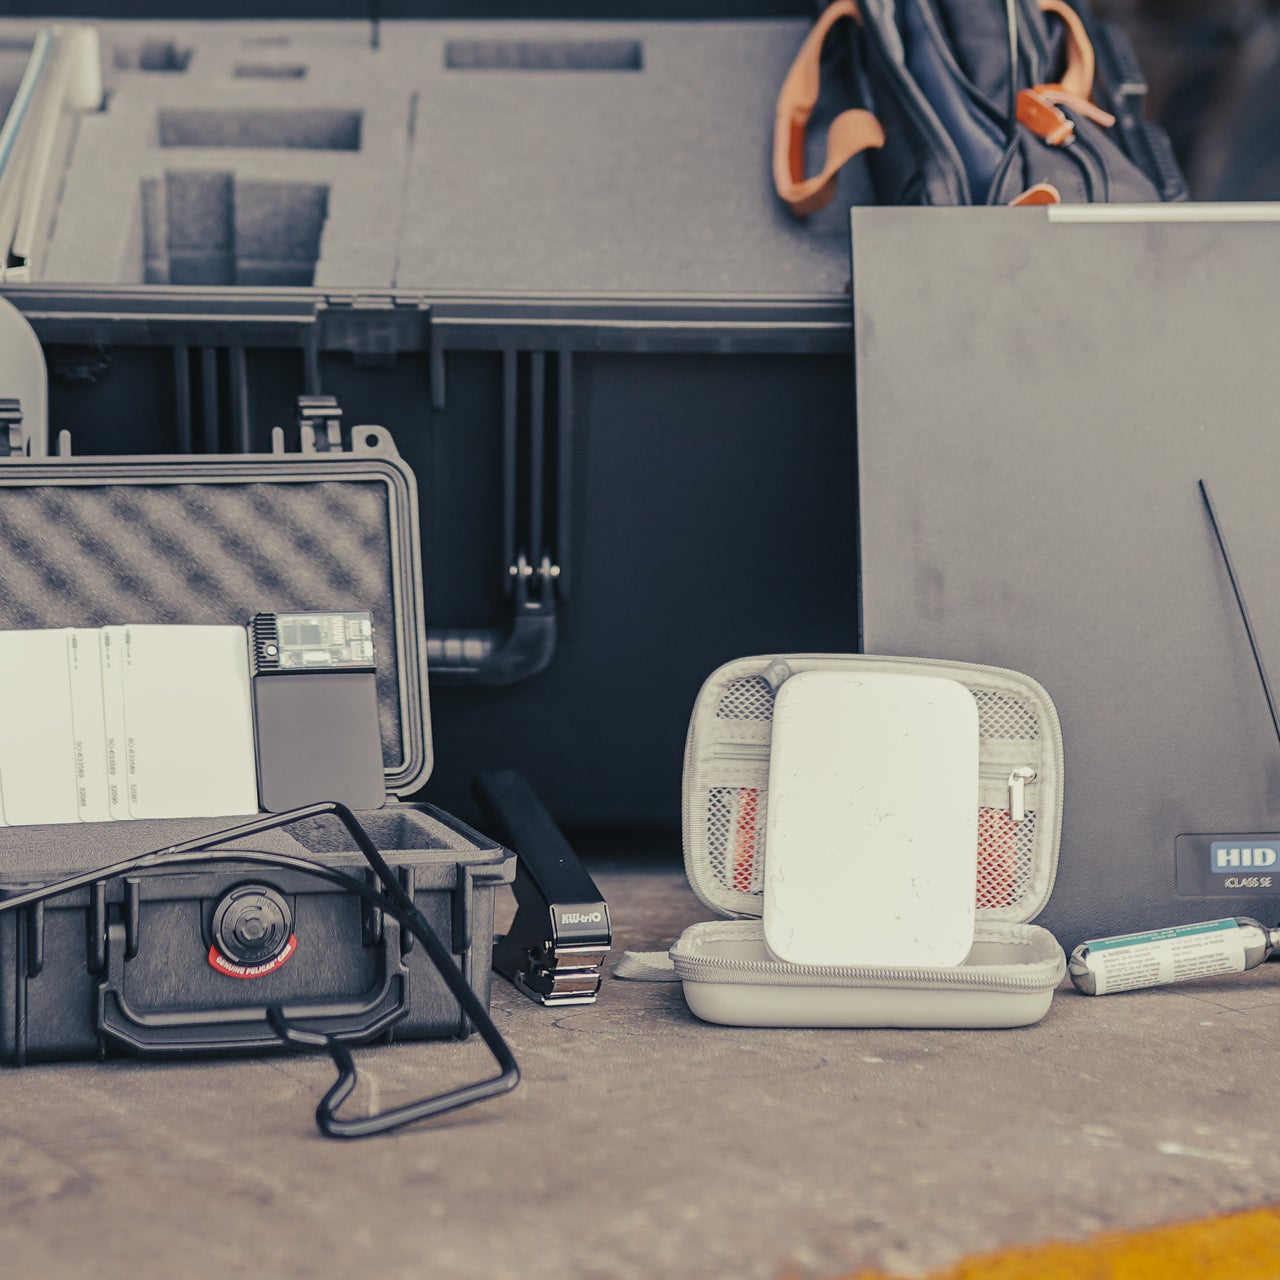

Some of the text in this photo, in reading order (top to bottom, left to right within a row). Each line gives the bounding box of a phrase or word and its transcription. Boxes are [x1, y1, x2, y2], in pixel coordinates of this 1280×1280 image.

[1216, 847, 1277, 868] HID
[1223, 876, 1274, 889] iCLASS SE
[216, 955, 246, 975] GENUINE
